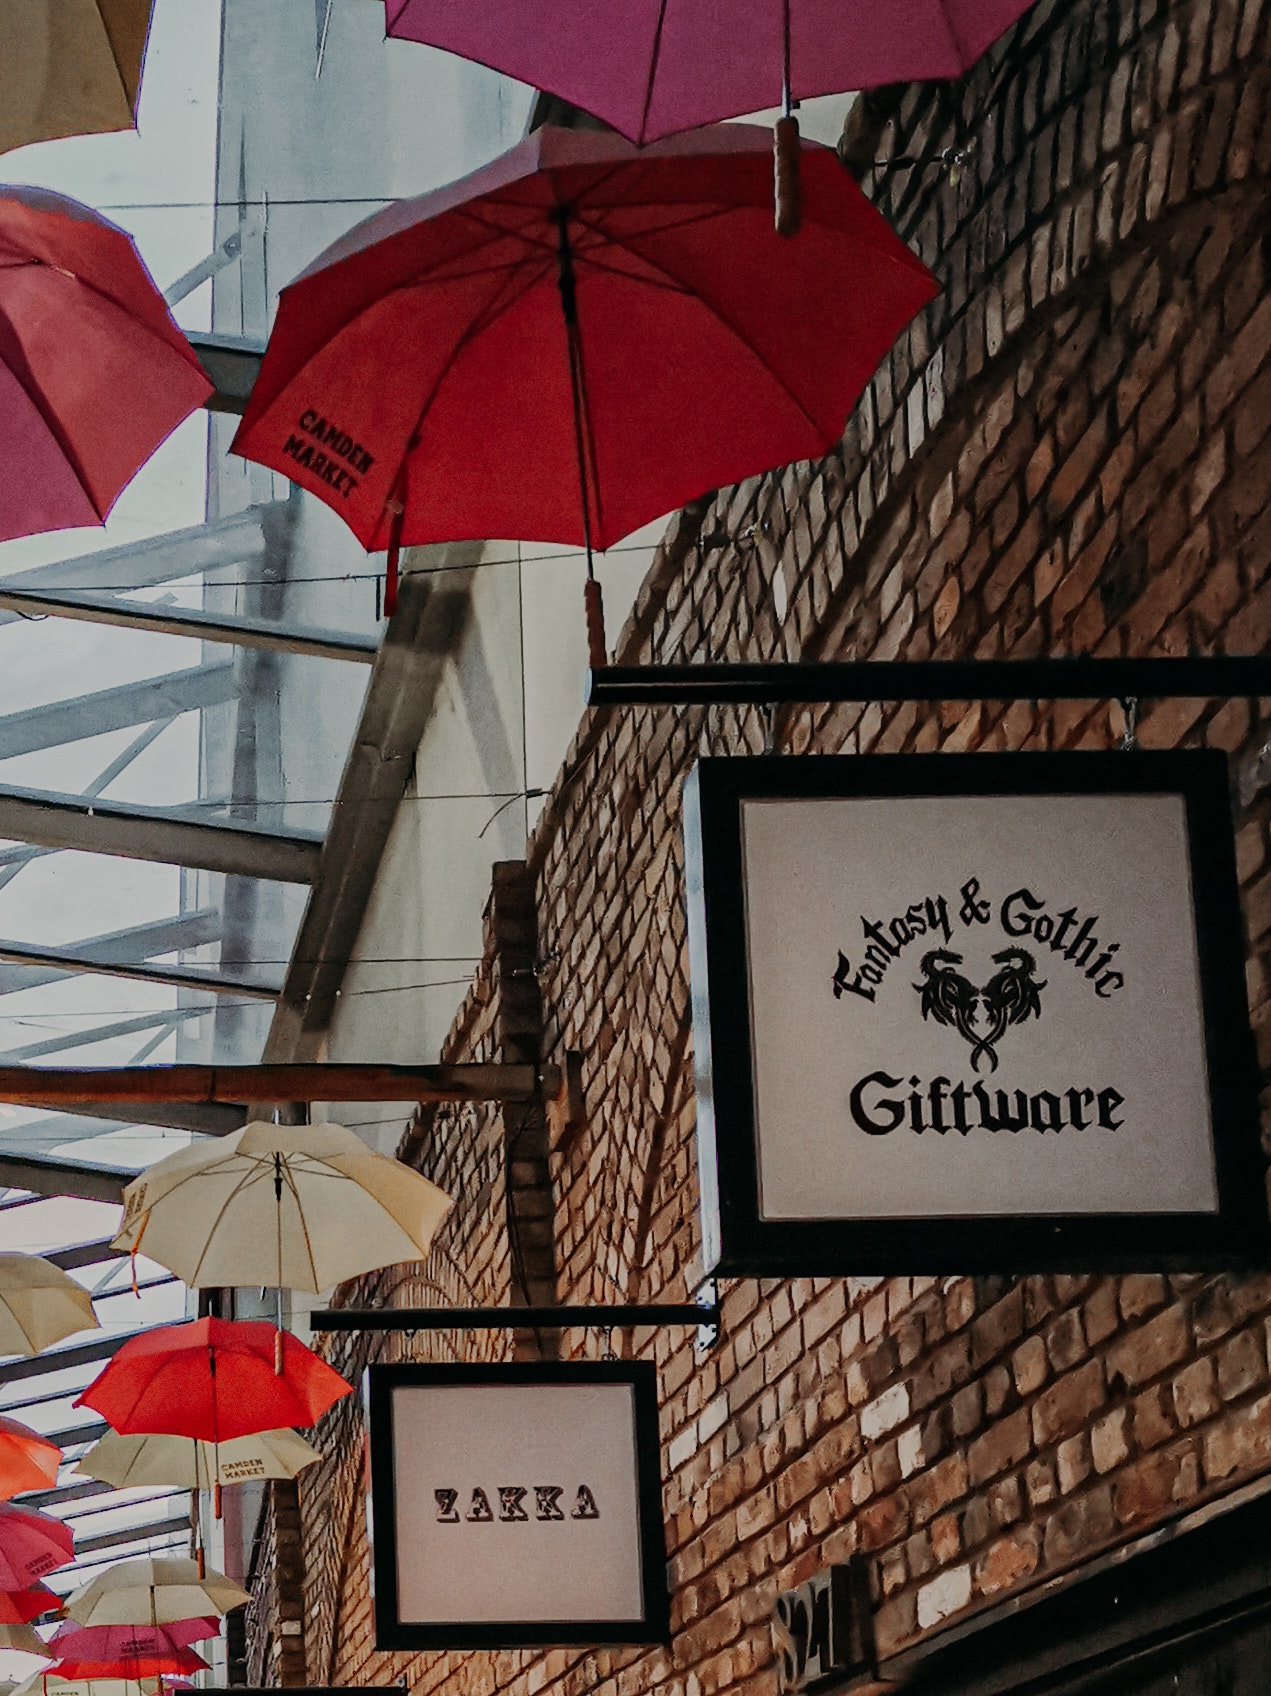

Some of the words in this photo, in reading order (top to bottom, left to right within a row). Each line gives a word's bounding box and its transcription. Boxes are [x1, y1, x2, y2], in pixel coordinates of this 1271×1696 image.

[281, 434, 359, 499] MARKET
[297, 408, 376, 474] CAMDEN
[832, 893, 954, 1003] Fantasy
[958, 876, 991, 927] &
[999, 888, 1125, 999] Gothic
[848, 1069, 1127, 1137] Giftware
[221, 1458, 264, 1471] CAMDEN
[224, 1467, 265, 1479] MARKET
[434, 1484, 600, 1523] ZAKKA
